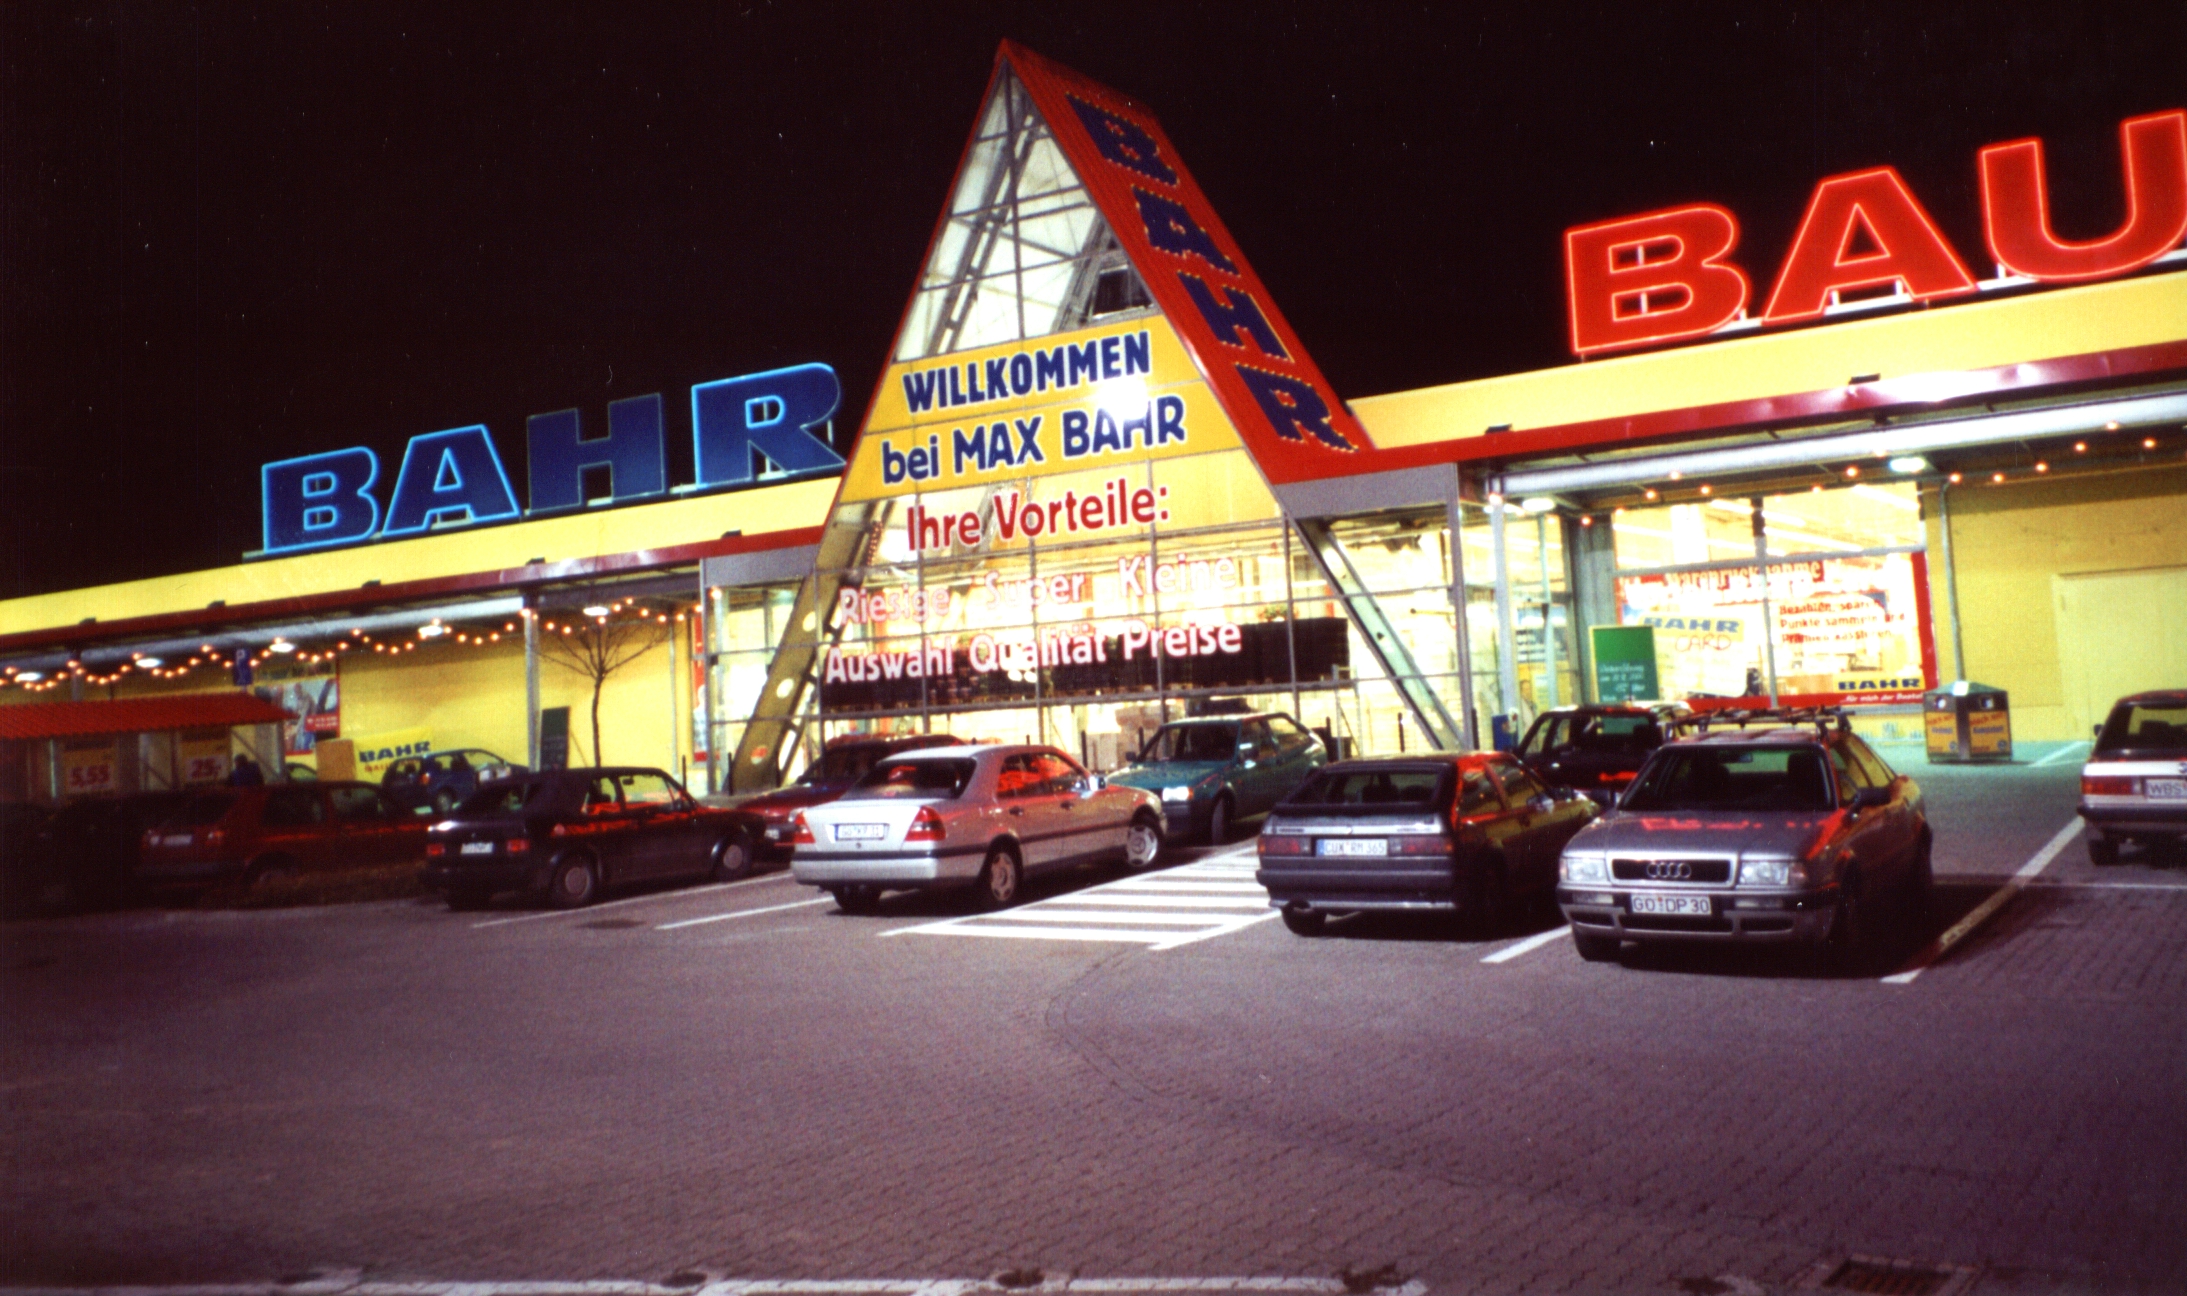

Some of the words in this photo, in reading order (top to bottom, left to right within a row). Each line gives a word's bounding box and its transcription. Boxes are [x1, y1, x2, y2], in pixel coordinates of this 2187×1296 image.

[1564, 109, 2187, 354] BAU
[1066, 91, 1358, 452] BAHR
[902, 331, 1150, 413] WILLKOMMEN
[261, 362, 847, 554] BAHR
[881, 435, 939, 484] bei
[953, 416, 1044, 474] MAX
[1063, 396, 1186, 457] BAHR
[907, 505, 981, 551] Ihre
[994, 478, 1169, 540] Vorteile:
[839, 586, 950, 626] Riesige
[985, 571, 1086, 611] Super
[1119, 553, 1236, 598] Kleine
[1643, 616, 1740, 633] BAHR
[826, 637, 954, 684] Auswahl
[968, 619, 1106, 673] Qualität
[1122, 620, 1242, 661] Preise
[1838, 678, 1920, 691] BAHR
[359, 740, 431, 763] BAHR
[1691, 898, 1709, 913] 30
